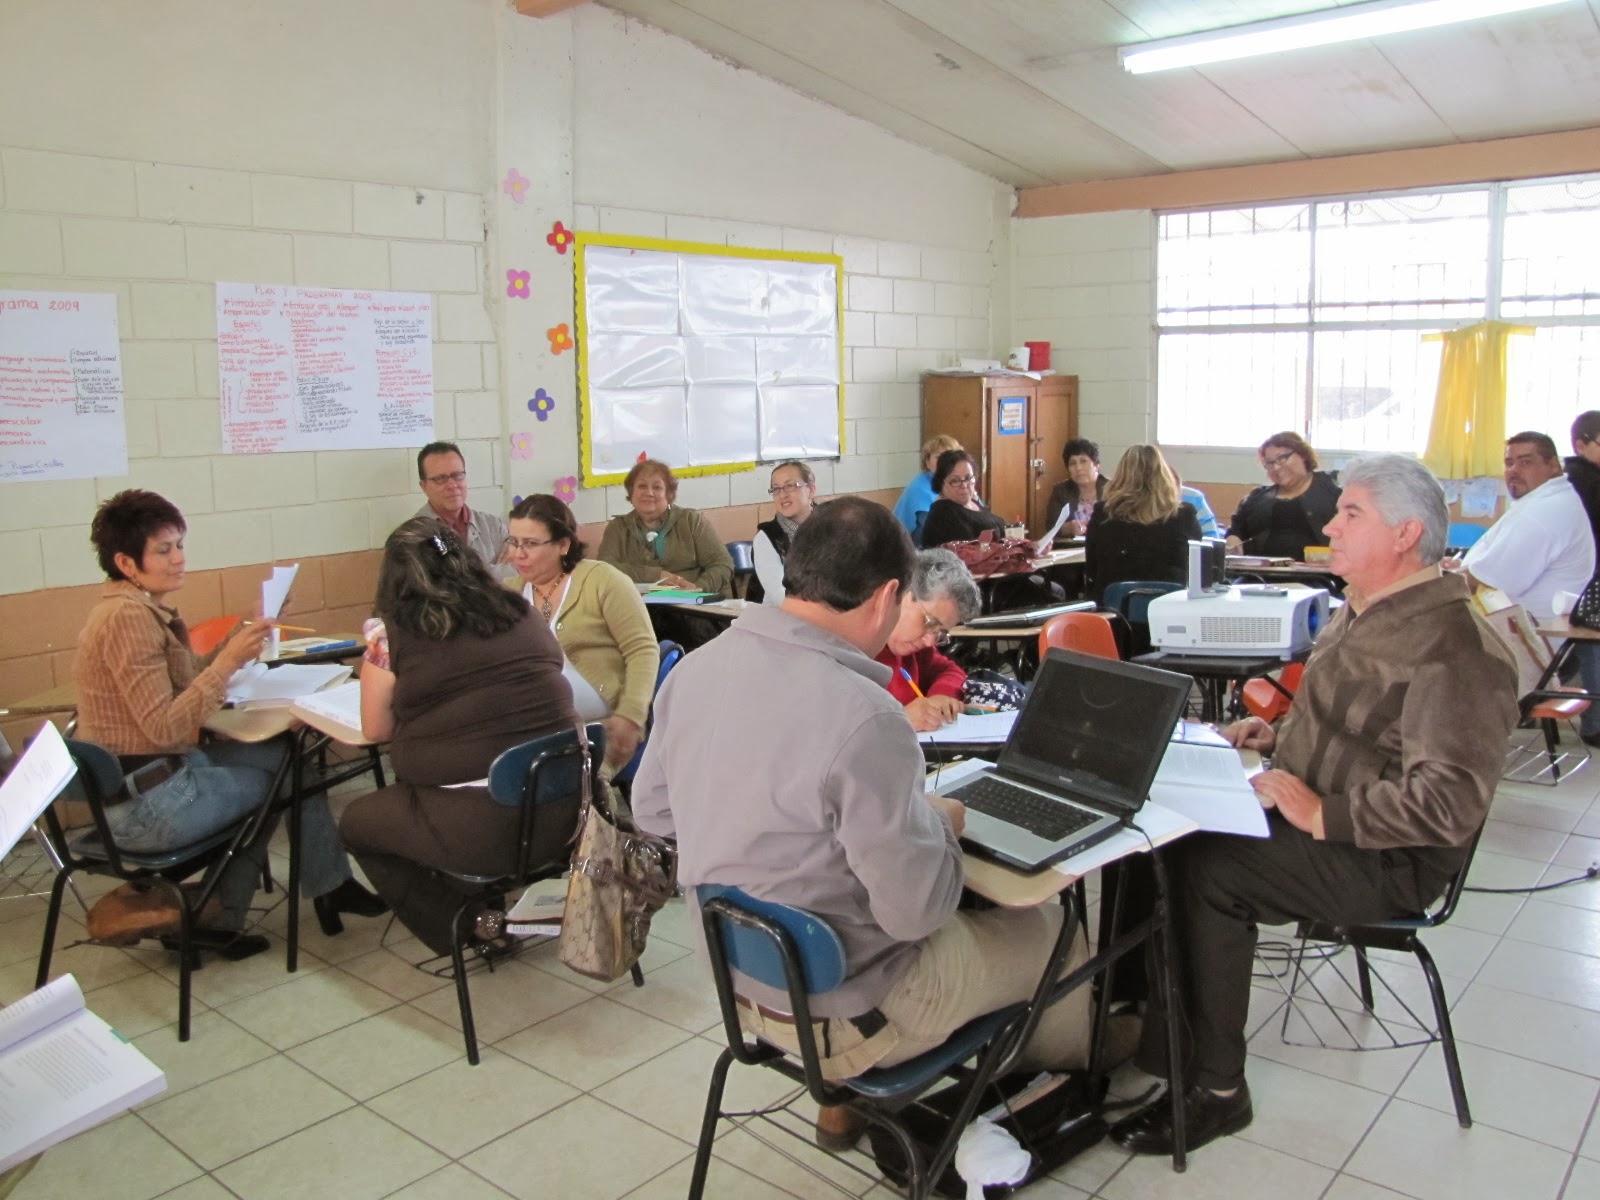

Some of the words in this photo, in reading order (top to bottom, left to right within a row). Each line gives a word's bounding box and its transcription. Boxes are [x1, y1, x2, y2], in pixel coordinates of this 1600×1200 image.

[255, 285, 276, 296] PLAN
[353, 292, 372, 303] 2009
[0, 299, 39, 315] rama
[48, 299, 80, 312] 2009
